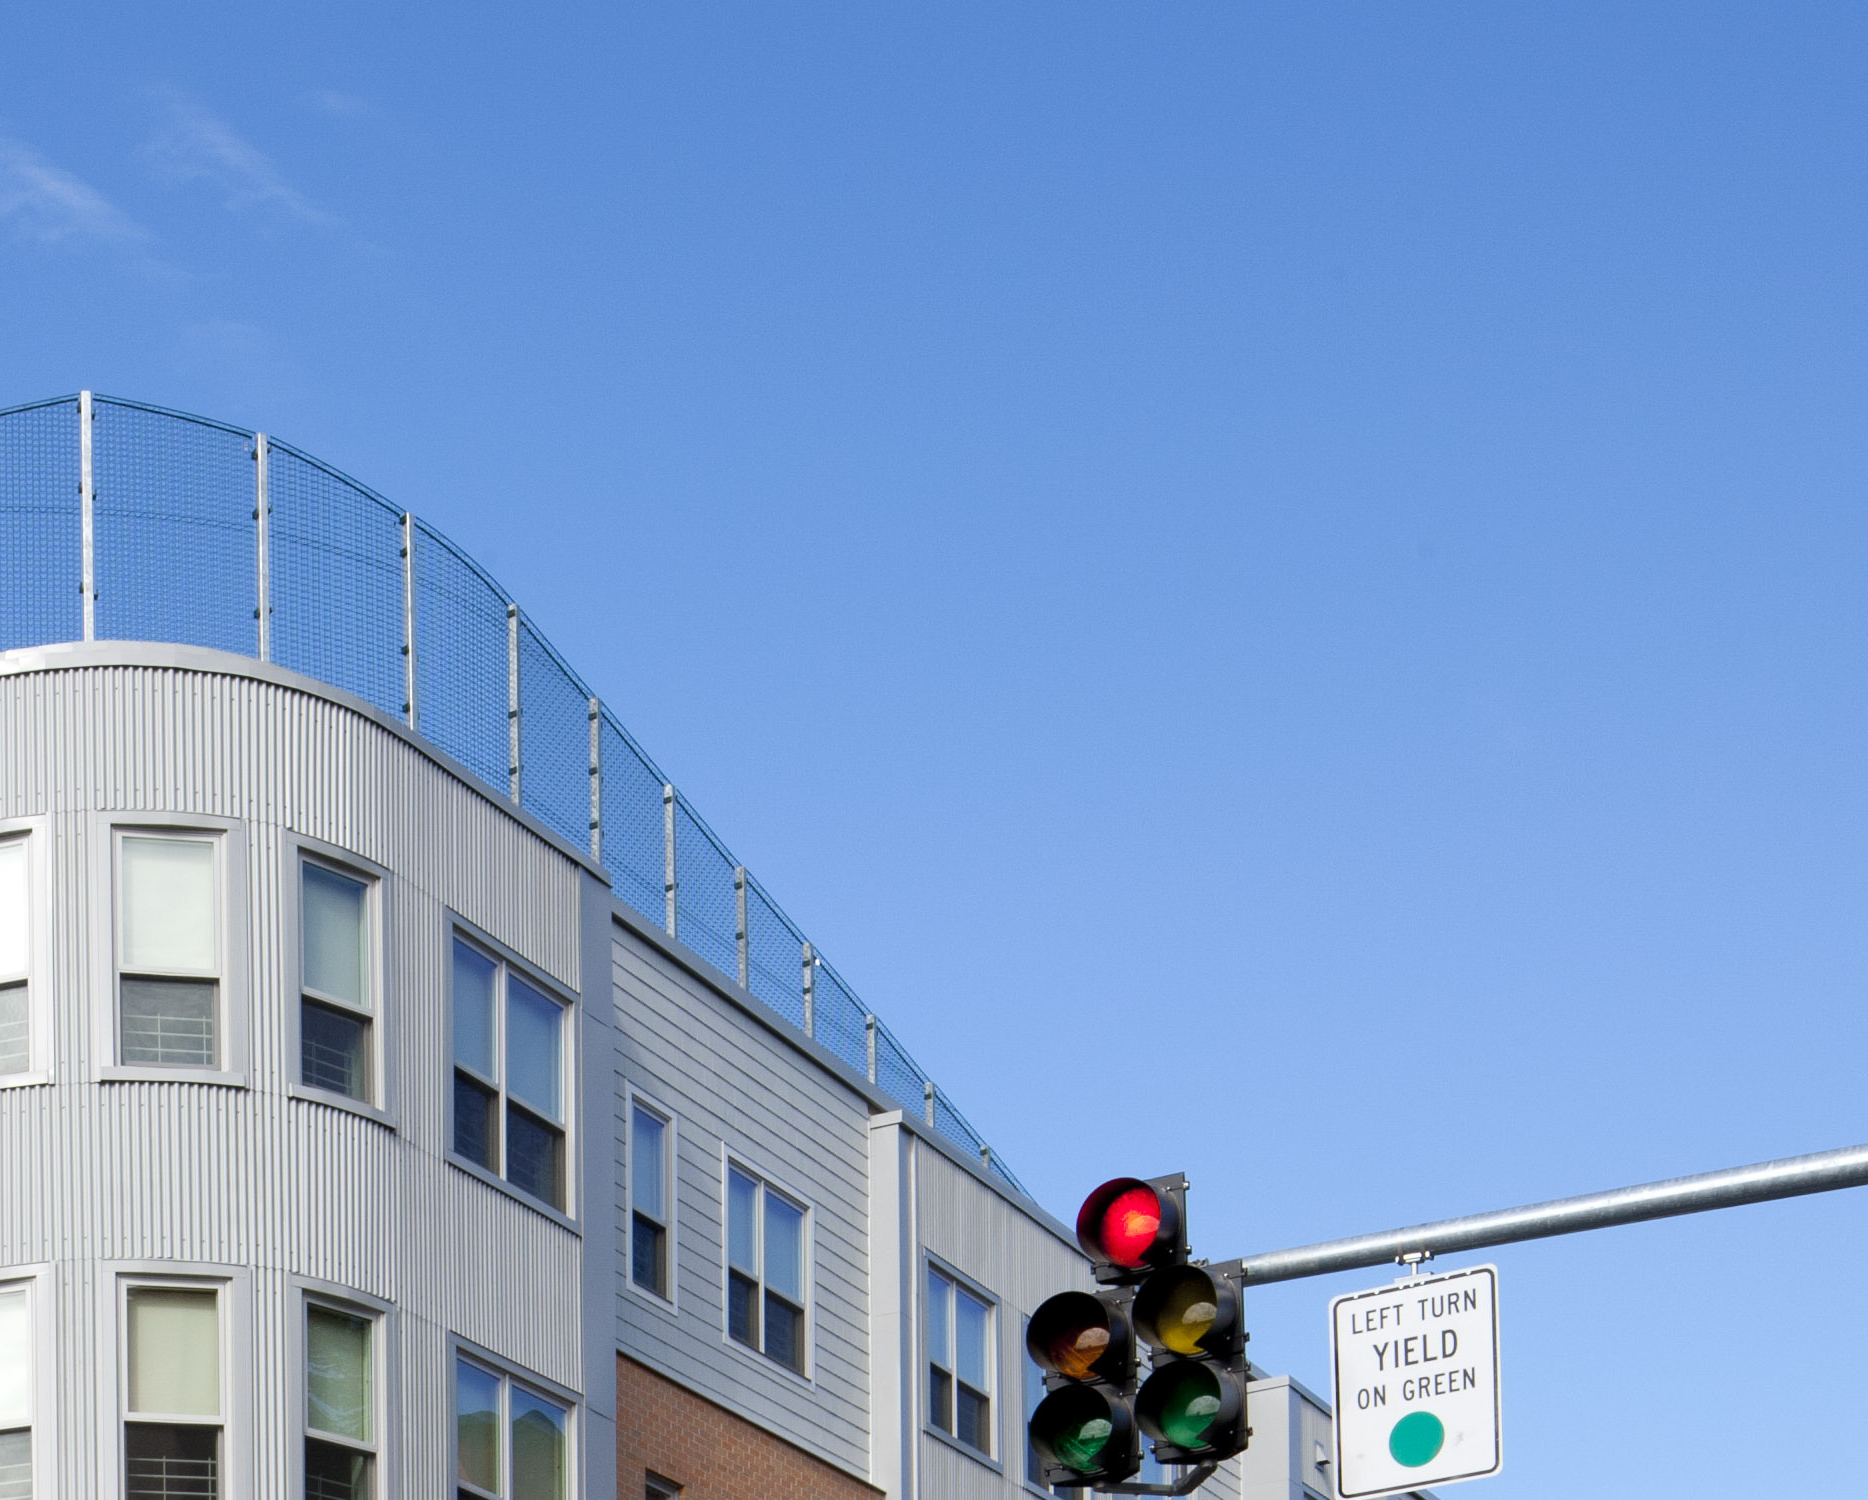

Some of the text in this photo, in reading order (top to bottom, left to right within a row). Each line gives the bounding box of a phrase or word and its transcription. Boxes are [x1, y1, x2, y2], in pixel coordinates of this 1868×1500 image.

[1352, 1288, 1477, 1335] LEFT TURN
[1372, 1328, 1458, 1372] YIELD
[1357, 1366, 1476, 1410] ON GREEN
